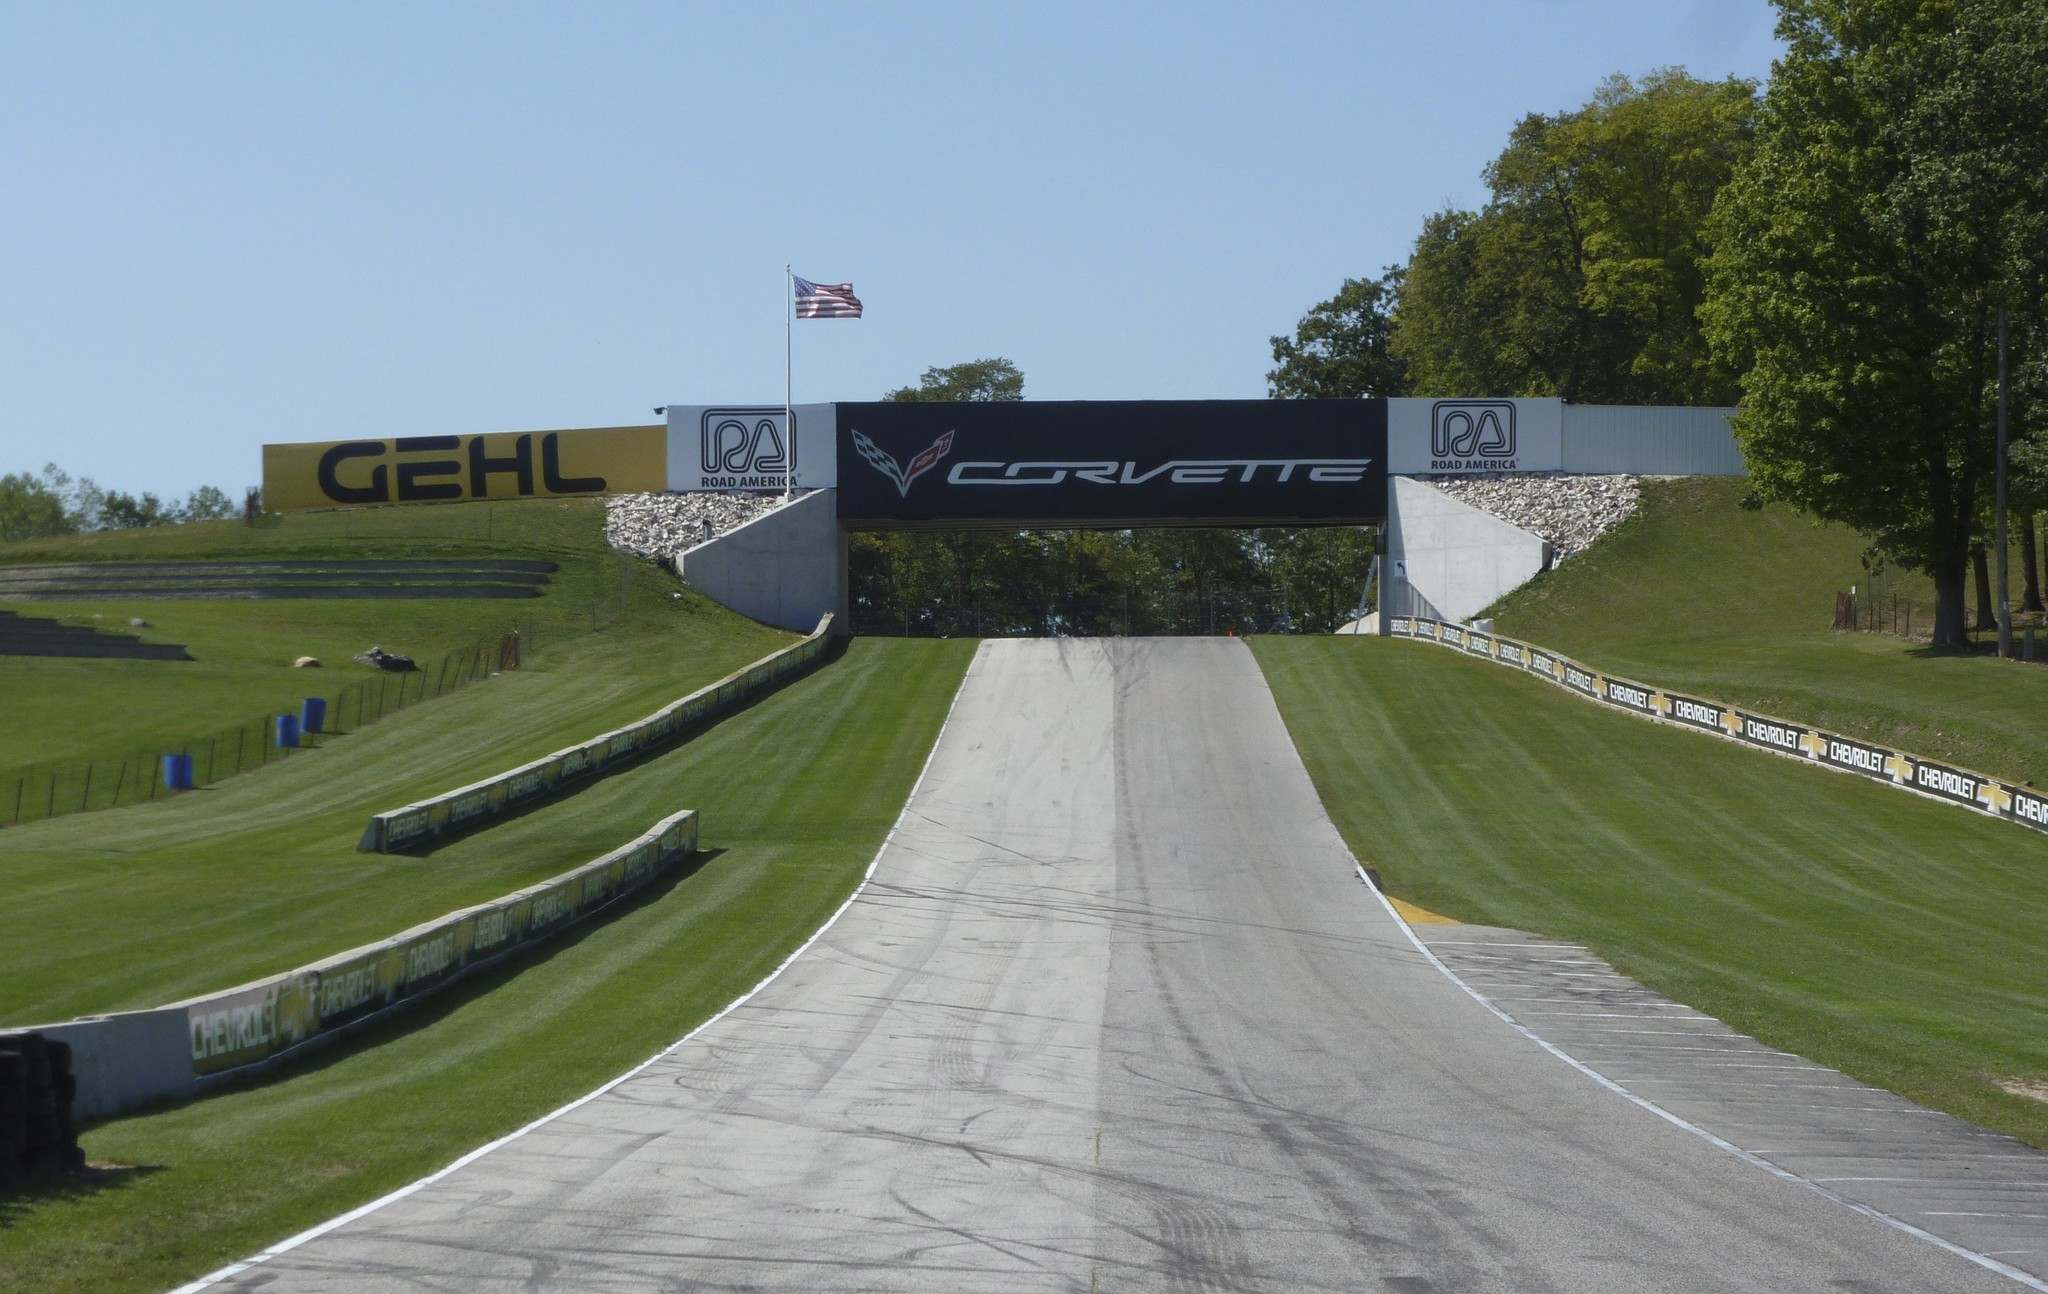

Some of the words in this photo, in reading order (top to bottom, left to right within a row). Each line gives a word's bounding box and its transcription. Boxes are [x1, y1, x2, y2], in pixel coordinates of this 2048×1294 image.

[317, 432, 608, 504] GEHL
[946, 458, 1373, 485] CORVETTE
[1431, 460, 1463, 470] ROAD
[1465, 459, 1517, 469] AMERICA
[701, 476, 737, 488] ROAD
[740, 475, 798, 487] AMERICA
[1609, 683, 1647, 709] CHEVROLET
[1675, 700, 1719, 726] CHEVROLET
[1747, 719, 1797, 749] CHEVROLET
[1830, 741, 1883, 773] CHEVROLET
[1918, 765, 1976, 800] CHEVROLET
